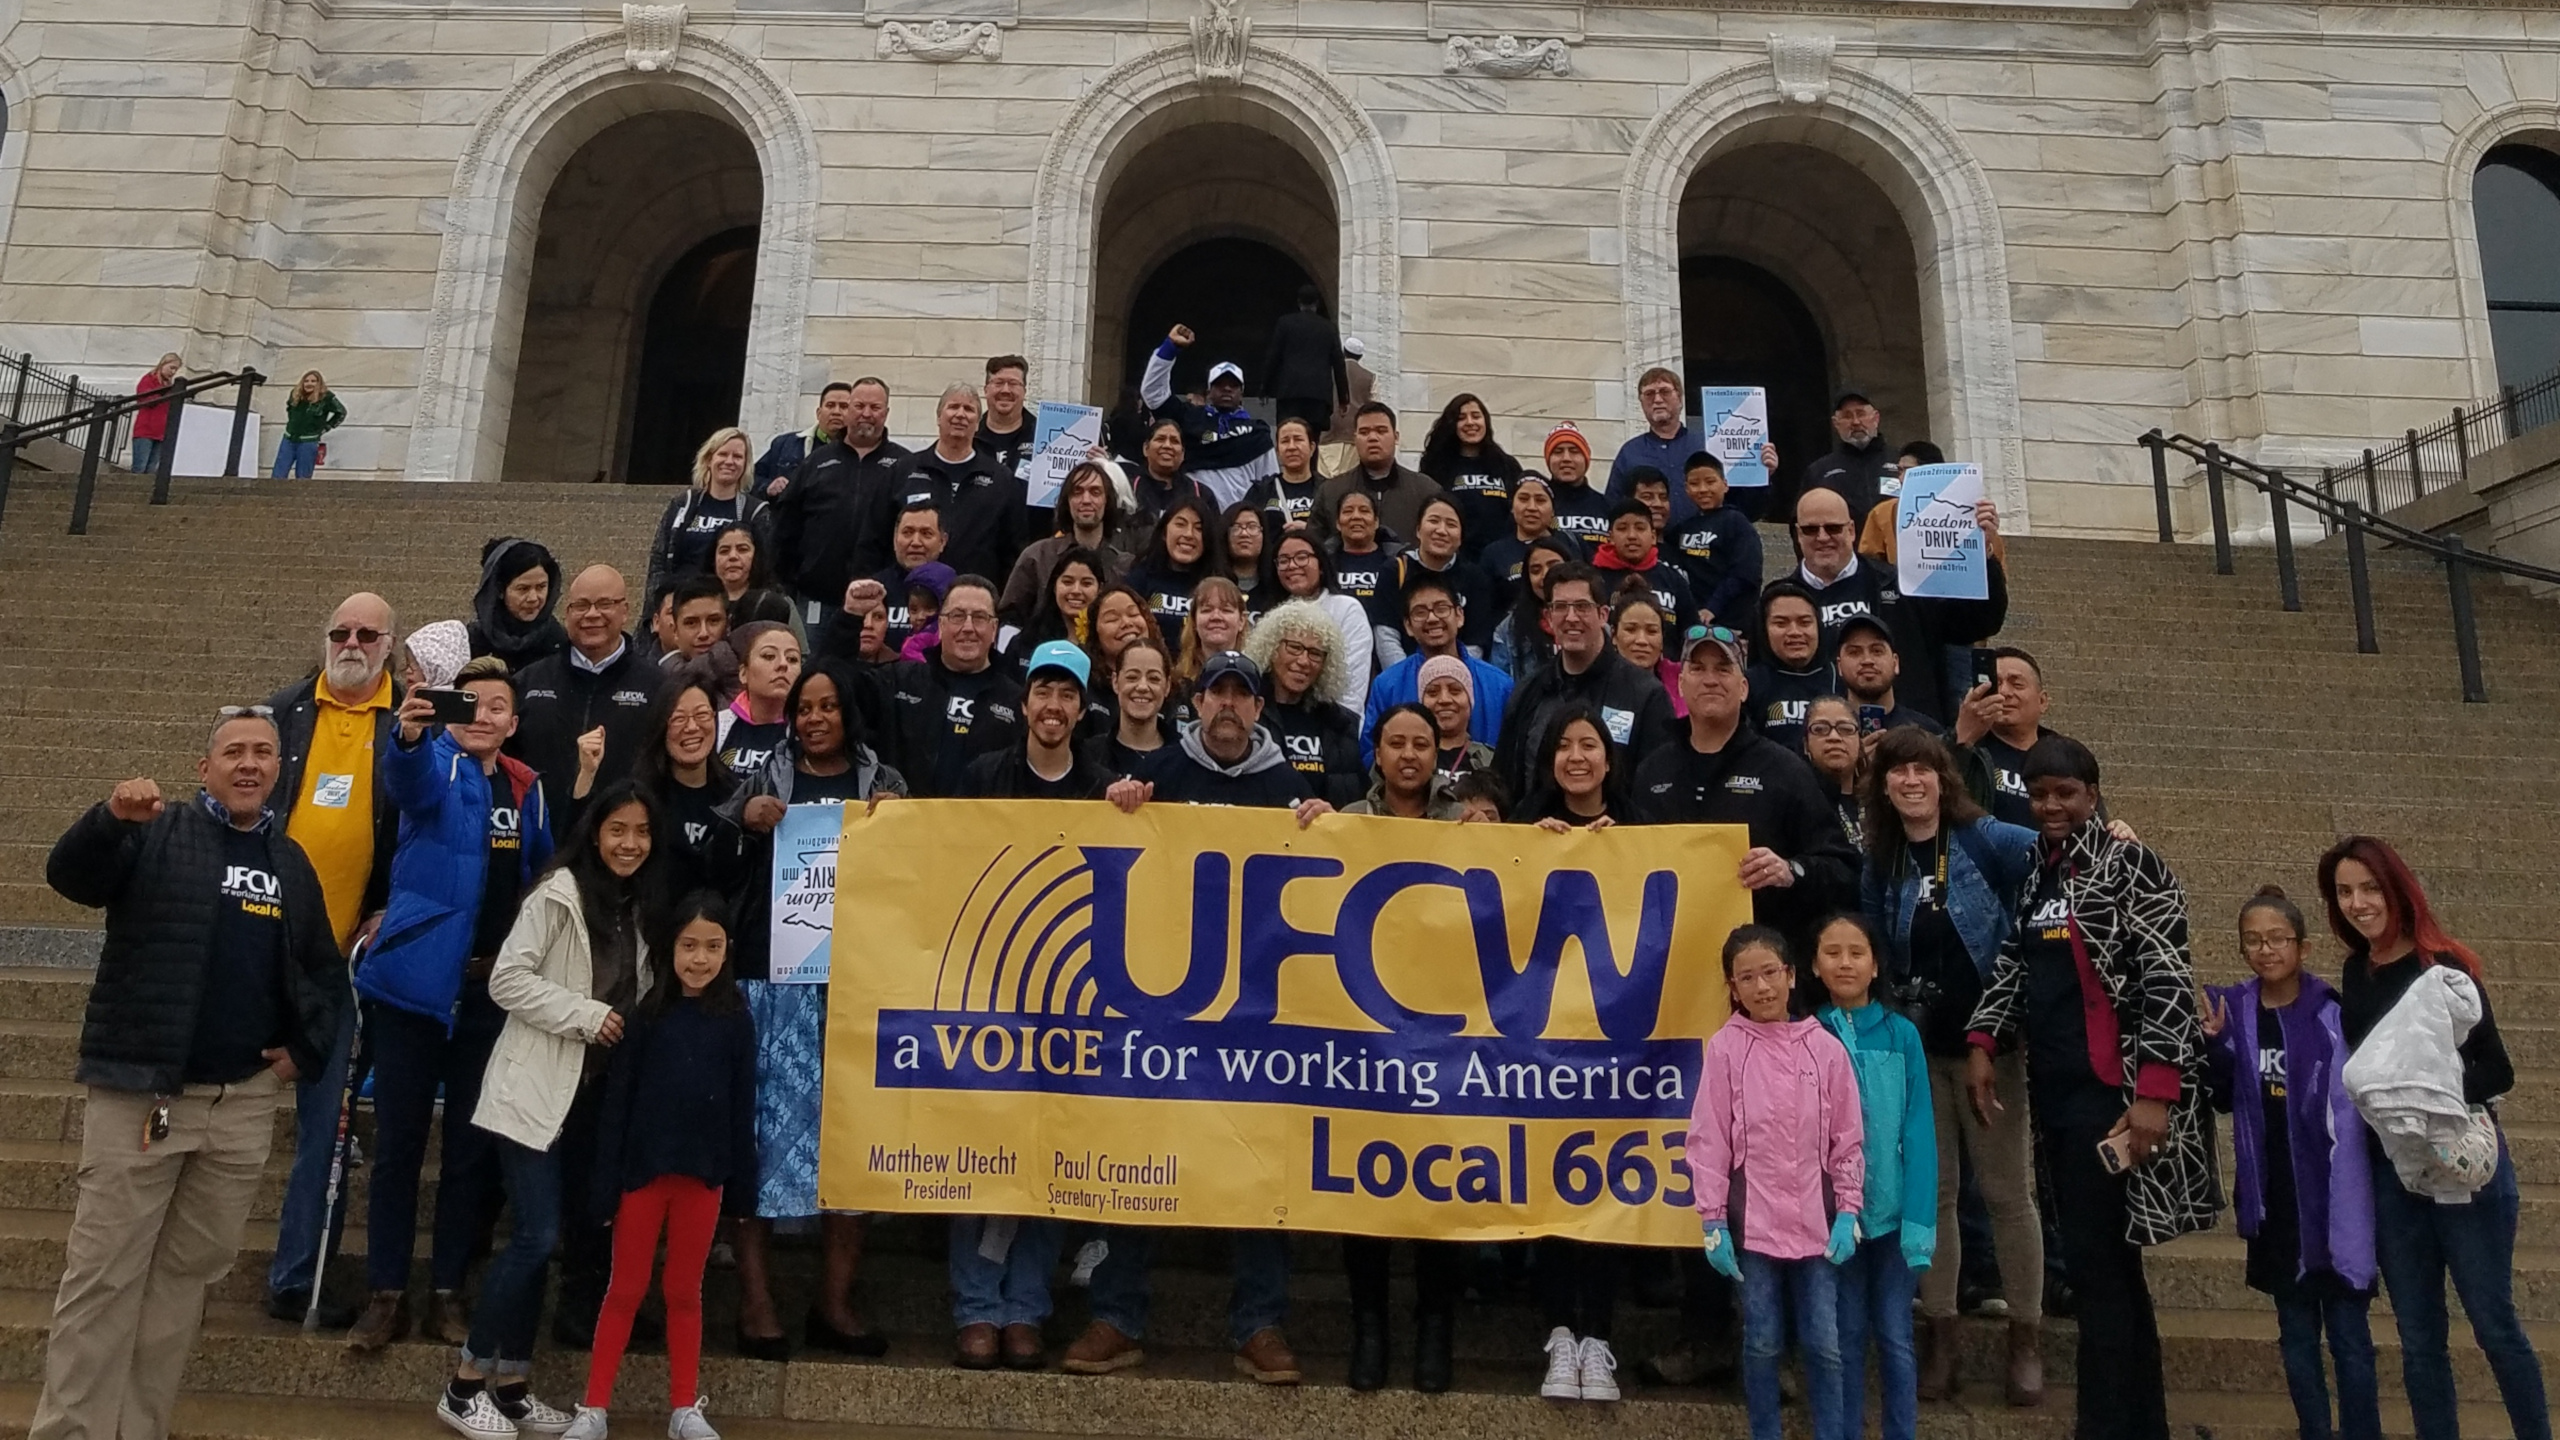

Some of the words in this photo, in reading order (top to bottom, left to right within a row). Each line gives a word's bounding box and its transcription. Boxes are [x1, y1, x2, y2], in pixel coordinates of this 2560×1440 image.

[1708, 425, 1761, 438] Freedom
[1037, 441, 1090, 458] Freedom
[1726, 438, 1752, 451] DRIVE
[1557, 516, 1610, 531] UFCW
[1902, 512, 1975, 529] Freedom
[1925, 530, 1961, 550] DRIVE
[1964, 539, 1978, 550] mn
[1161, 593, 1194, 612] UFC
[888, 607, 911, 624] UF
[947, 696, 975, 717] FC
[1781, 700, 1810, 719] UF
[1285, 735, 1323, 756] FCW
[1292, 762, 1319, 773] Local
[1734, 775, 1761, 786] UFCW
[491, 837, 516, 849] Local
[782, 868, 800, 881] mn
[804, 866, 835, 889] RIVE
[1938, 855, 1946, 882] Nikon
[231, 889, 261, 902] working
[242, 899, 271, 916] Local
[1078, 845, 1679, 1040] UFCW
[2042, 927, 2061, 940] Local
[893, 1033, 920, 1070] a
[932, 1023, 1103, 1077] VOICE
[1121, 1029, 1198, 1081] for
[1218, 1040, 1440, 1107] working
[1457, 1050, 1685, 1101] America
[868, 1144, 950, 1176] Matthew
[956, 1146, 1018, 1177] Utecht
[1054, 1151, 1091, 1183] Paul
[1097, 1153, 1178, 1187] Crandall
[1310, 1115, 1529, 1206] Local
[1552, 1129, 1698, 1208] 663
[904, 1178, 972, 1201] President
[1047, 1182, 1179, 1214] Secretary-Treasurer
